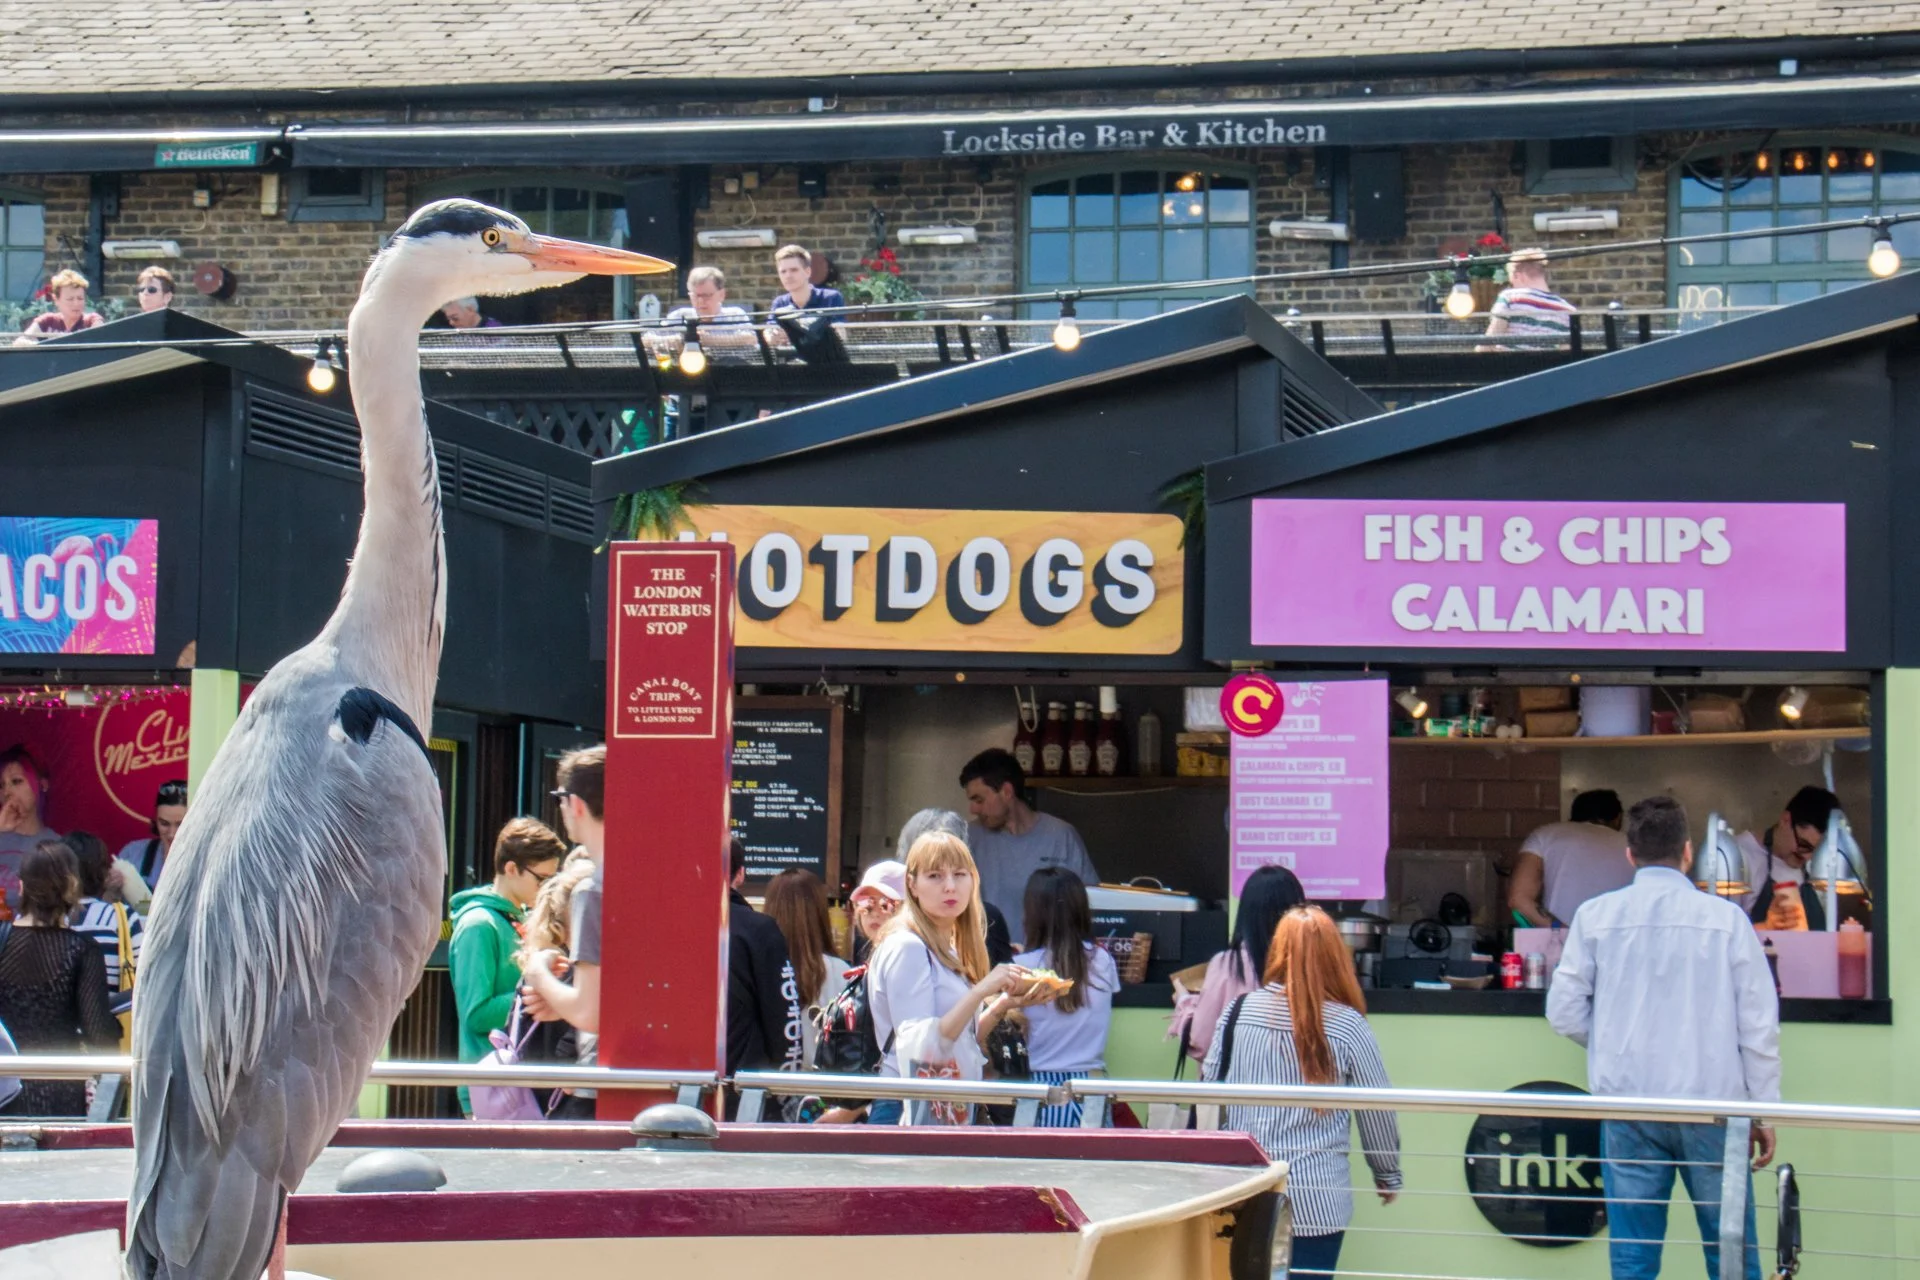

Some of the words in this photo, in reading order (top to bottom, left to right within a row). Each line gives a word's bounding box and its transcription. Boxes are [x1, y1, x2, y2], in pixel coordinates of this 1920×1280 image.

[942, 125, 1086, 154] Lockside
[1095, 125, 1155, 148] Bar
[1162, 122, 1188, 147] &
[1197, 118, 1327, 146] Kitchen
[1364, 514, 1483, 562] FISH
[1500, 516, 1545, 565] &
[1558, 517, 1732, 566] CHIPS
[650, 568, 686, 581] THE
[679, 531, 1156, 616] OTDOGS
[634, 586, 703, 599] LONDON
[622, 604, 712, 617] WATERBUS
[1391, 582, 1705, 635] CALAMARI
[646, 621, 688, 635] STOP
[629, 677, 668, 701] CANAL
[672, 678, 702, 701] BOAT
[649, 692, 681, 701] TRIPS
[627, 706, 639, 714] TO
[640, 706, 670, 714] LITTLE
[671, 706, 703, 714] VENICE
[642, 715, 677, 723] LONDON
[678, 715, 695, 723] ZOO
